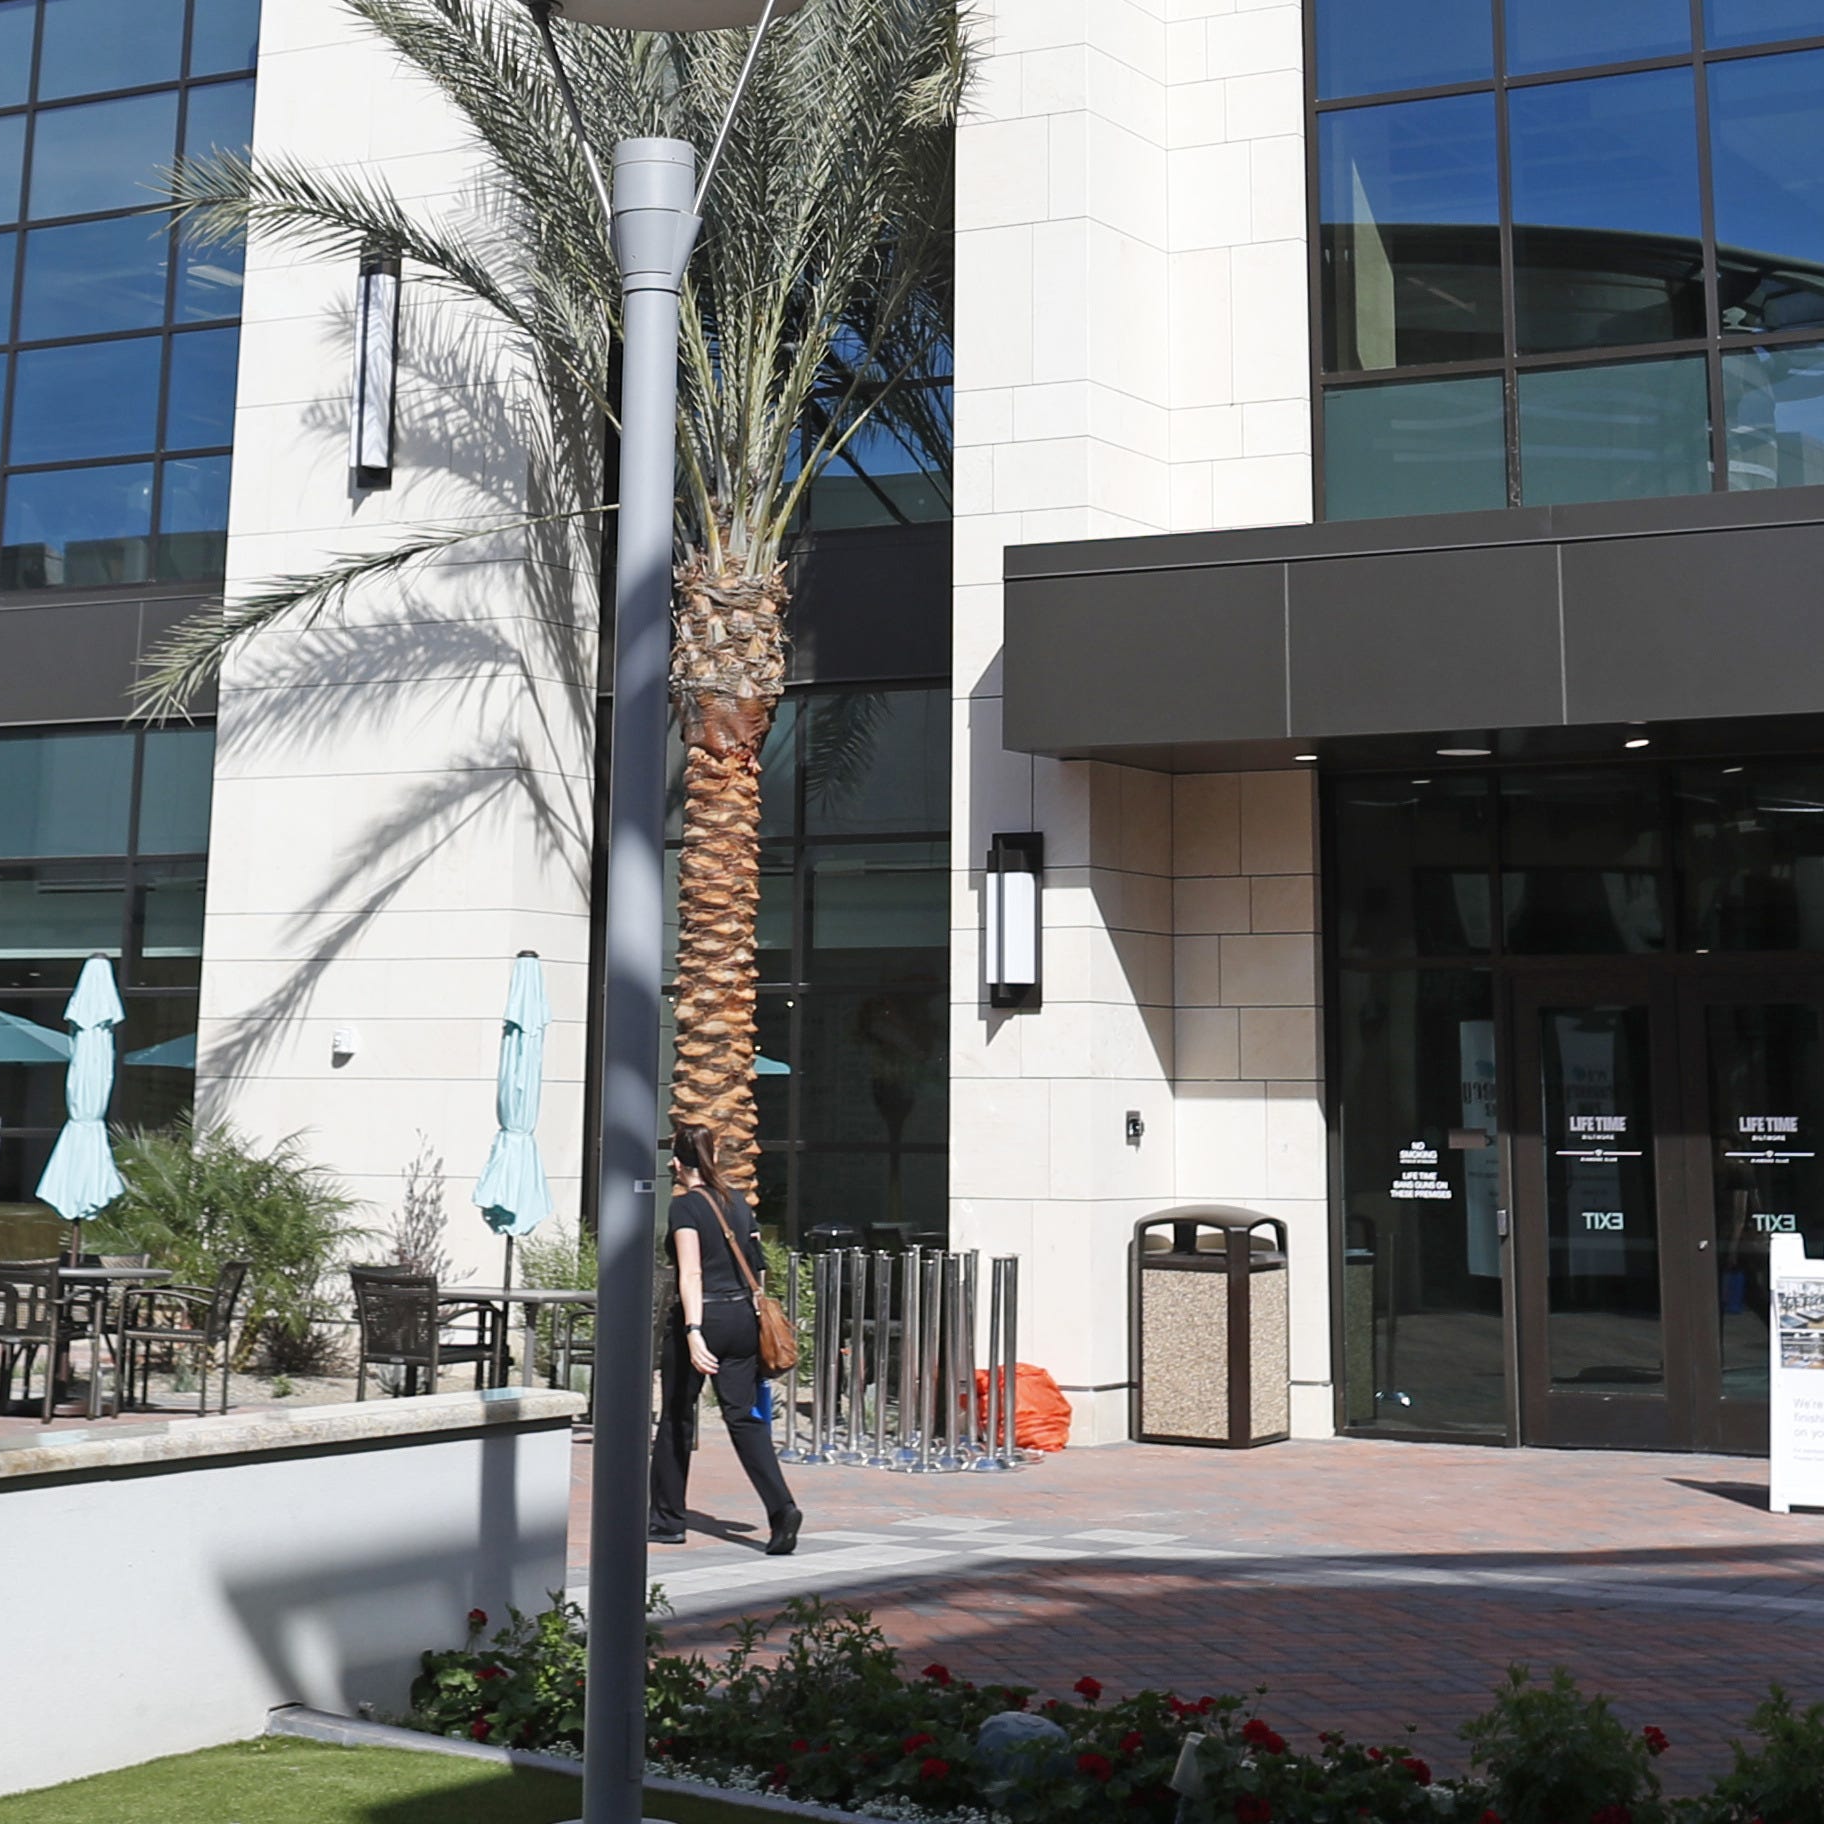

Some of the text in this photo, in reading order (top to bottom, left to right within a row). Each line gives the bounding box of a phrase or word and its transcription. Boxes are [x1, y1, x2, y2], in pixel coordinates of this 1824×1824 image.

[1569, 1116, 1627, 1132] LIFE TIME
[1739, 1116, 1799, 1133] LIFE TIME
[1411, 1141, 1426, 1151] NO
[1399, 1150, 1438, 1159] SMOKING
[1401, 1172, 1438, 1181] LIFE TIME
[1393, 1180, 1449, 1190] BANS GUNS ON
[1390, 1189, 1452, 1199] THESE PREMISES
[1793, 1398, 1824, 1410] We're
[1793, 1428, 1808, 1438] on
